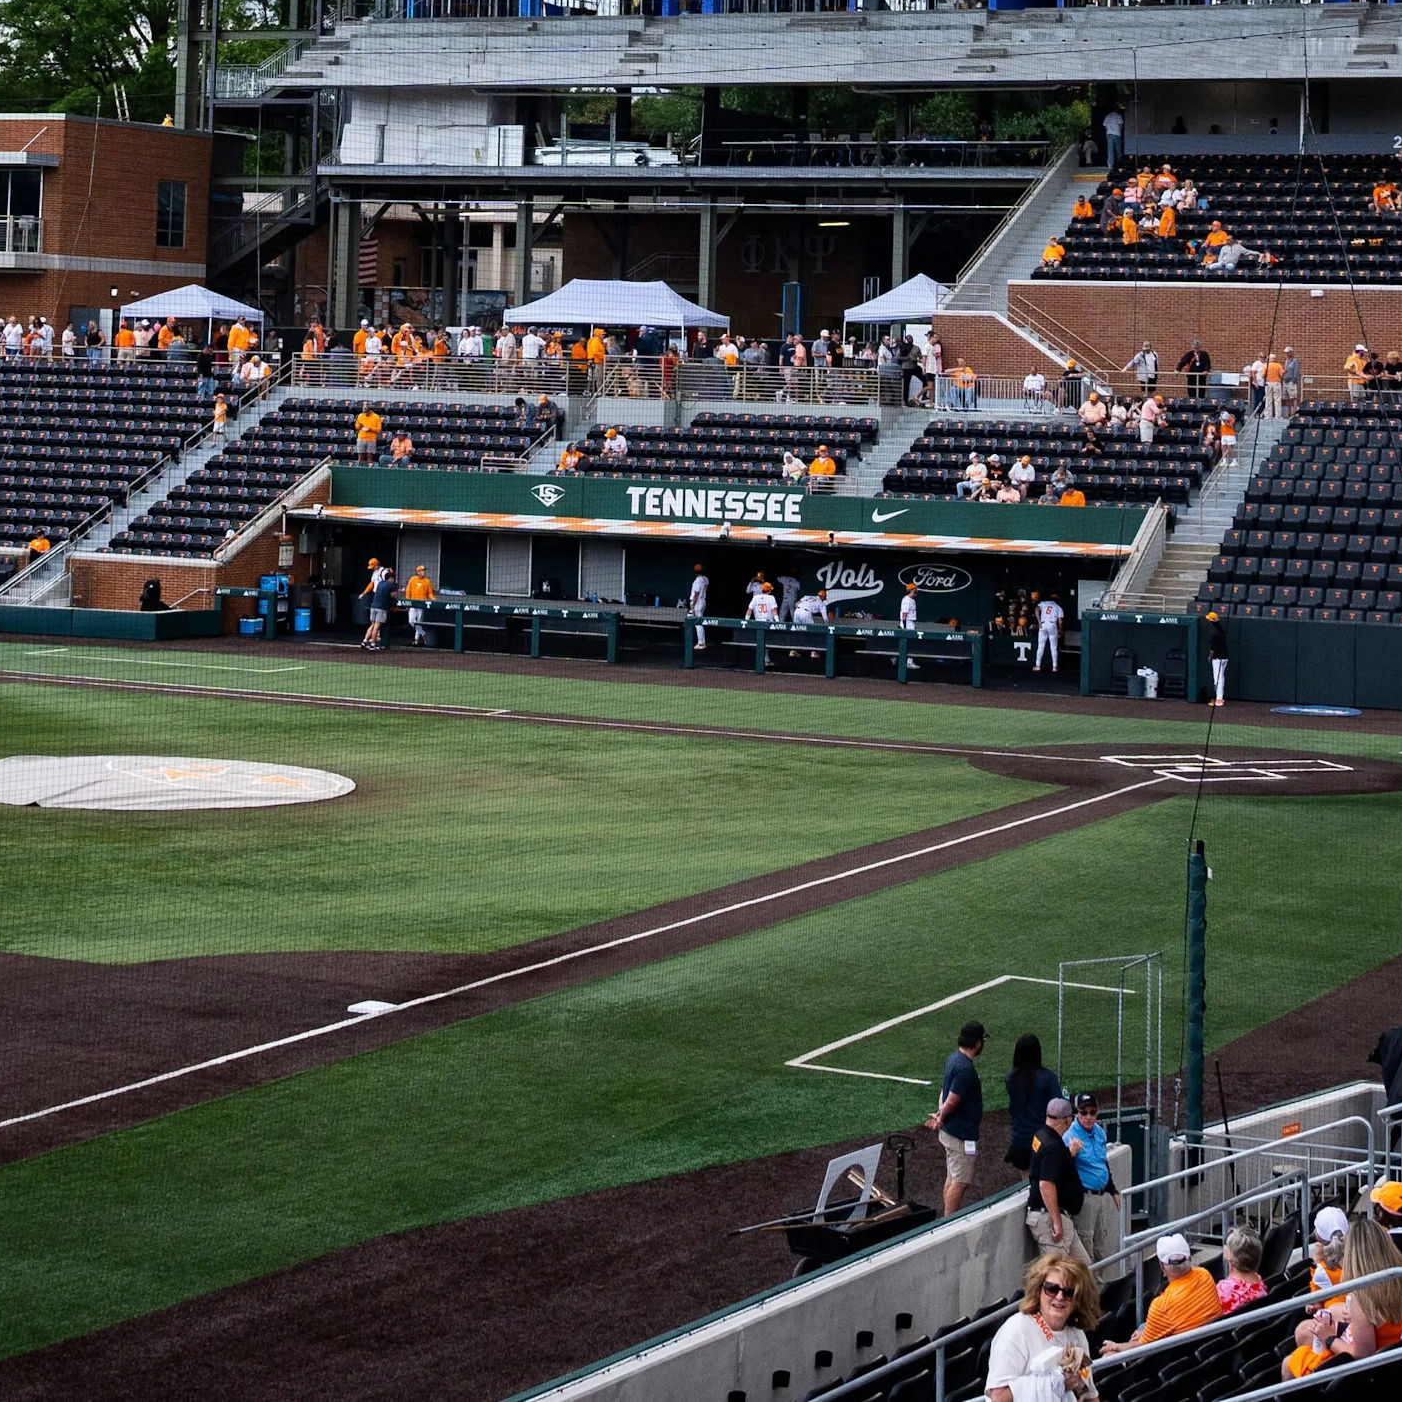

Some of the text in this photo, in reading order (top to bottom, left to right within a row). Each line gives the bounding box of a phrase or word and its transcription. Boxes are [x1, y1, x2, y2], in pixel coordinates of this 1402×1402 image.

[626, 486, 804, 523] TENNESSEE
[816, 561, 879, 590] Vols
[913, 566, 956, 588] Ford
[757, 603, 768, 614] 30
[1046, 605, 1053, 615] 6
[1013, 641, 1032, 662] T
[1033, 1313, 1054, 1342] ANGE
